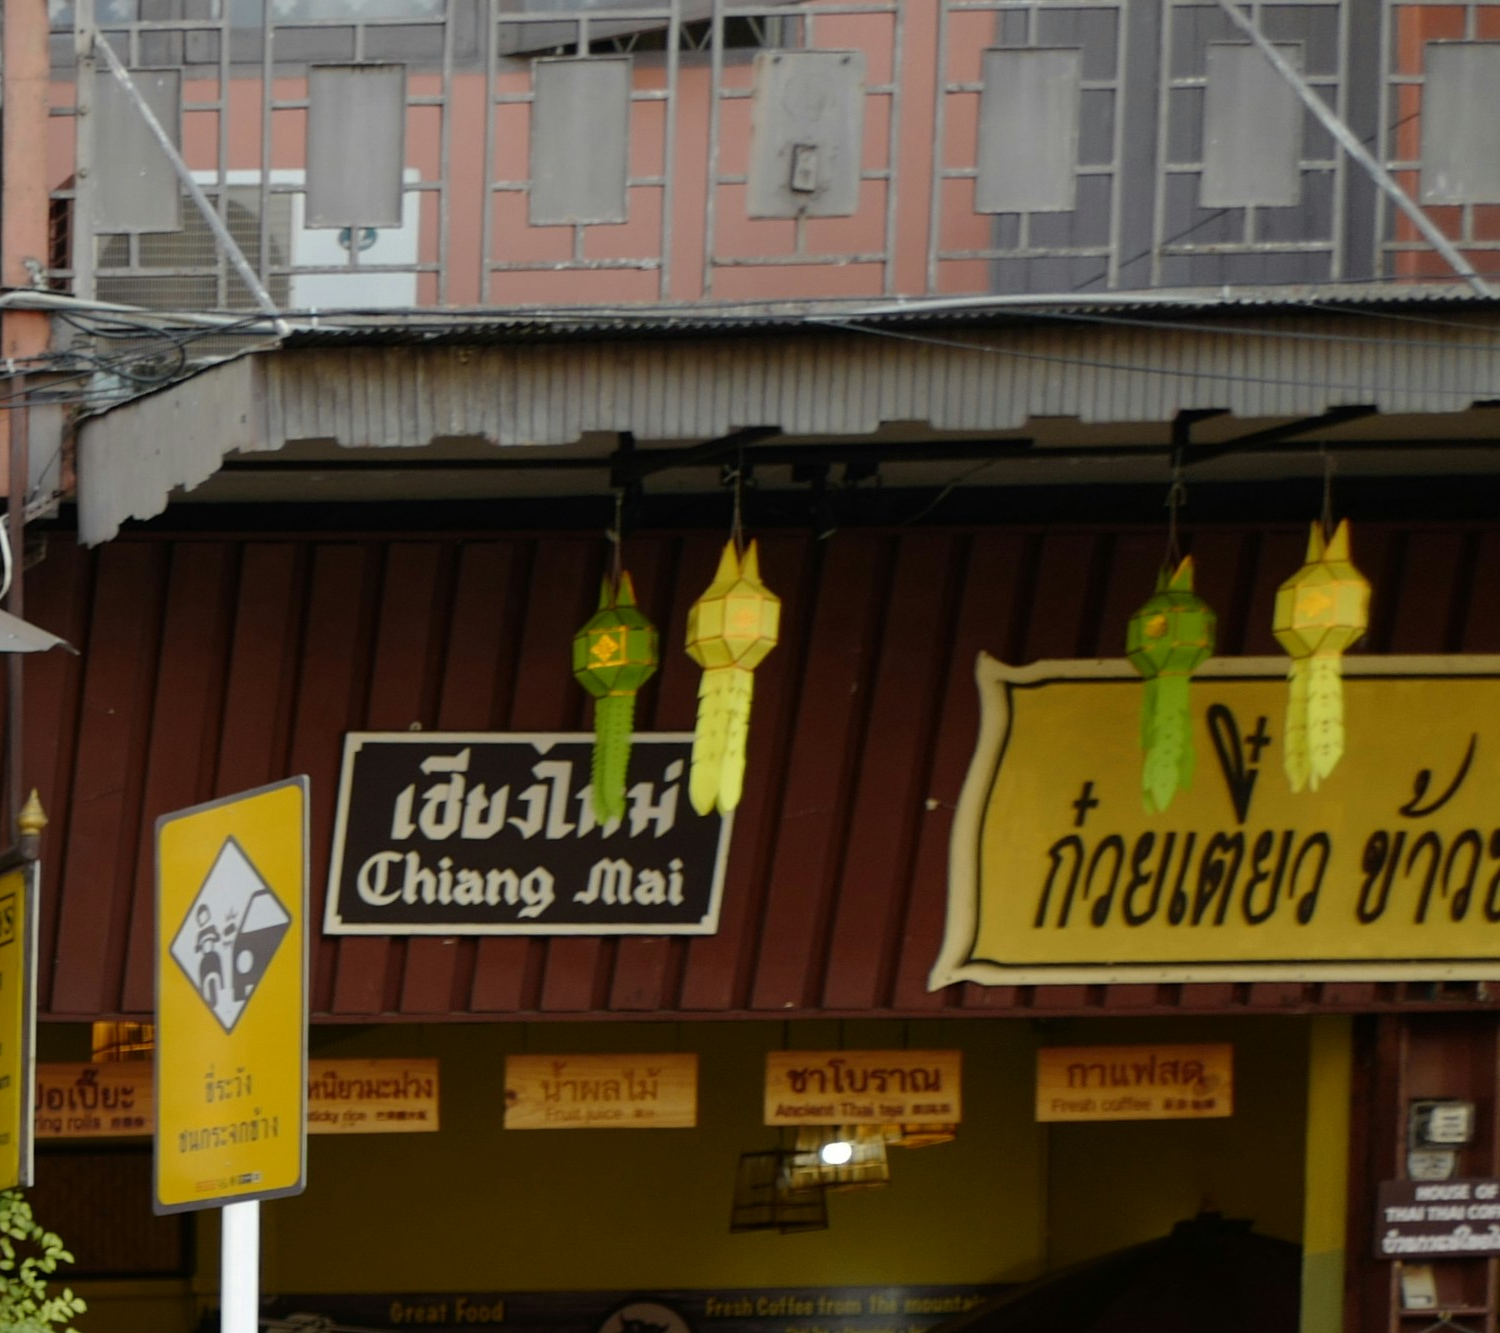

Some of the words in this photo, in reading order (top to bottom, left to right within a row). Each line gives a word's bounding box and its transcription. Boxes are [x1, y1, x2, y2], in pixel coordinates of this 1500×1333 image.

[357, 850, 555, 929] Chiang
[572, 856, 685, 916] Mai
[307, 1070, 434, 1100] หนียวมะม่วง
[786, 1059, 942, 1094] ชาโบราณ
[1415, 1184, 1470, 1201] HOUSE
[389, 1299, 449, 1325] Great
[454, 1296, 507, 1325] Food
[705, 1296, 754, 1317] Fresh
[755, 1296, 815, 1317] Coffee
